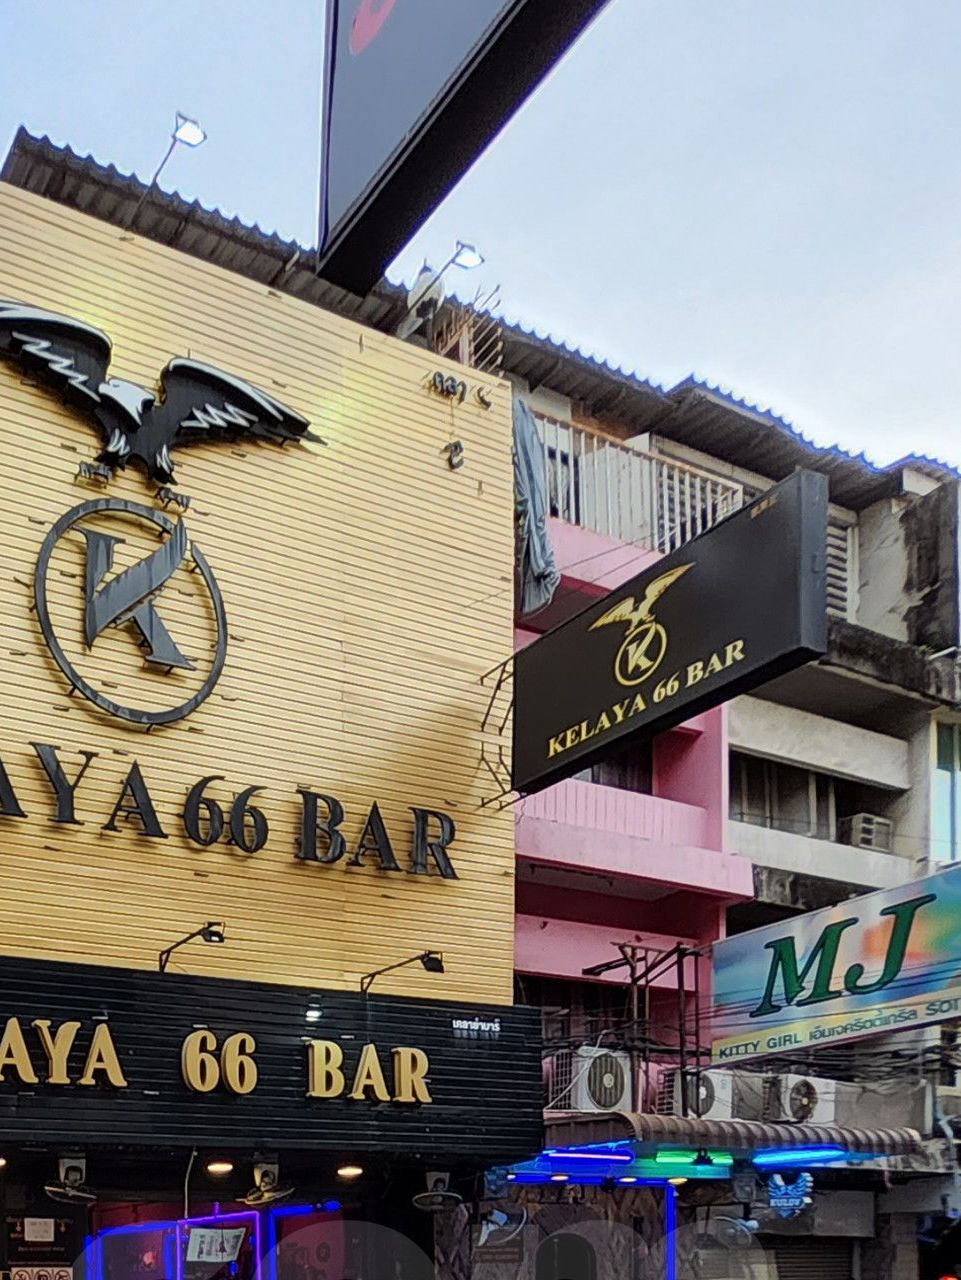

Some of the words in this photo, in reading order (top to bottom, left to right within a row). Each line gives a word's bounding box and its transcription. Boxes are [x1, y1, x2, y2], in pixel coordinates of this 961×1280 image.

[546, 693, 647, 759] KELAYA
[653, 672, 680, 703] 66
[685, 639, 746, 689] BAR
[183, 775, 269, 854] 66
[295, 788, 460, 880] BAR
[749, 893, 937, 1018] MJ
[181, 1029, 258, 1095] 66
[304, 1038, 433, 1104] BAR
[719, 1039, 761, 1060] KITTY
[766, 1033, 803, 1050] GIRL
